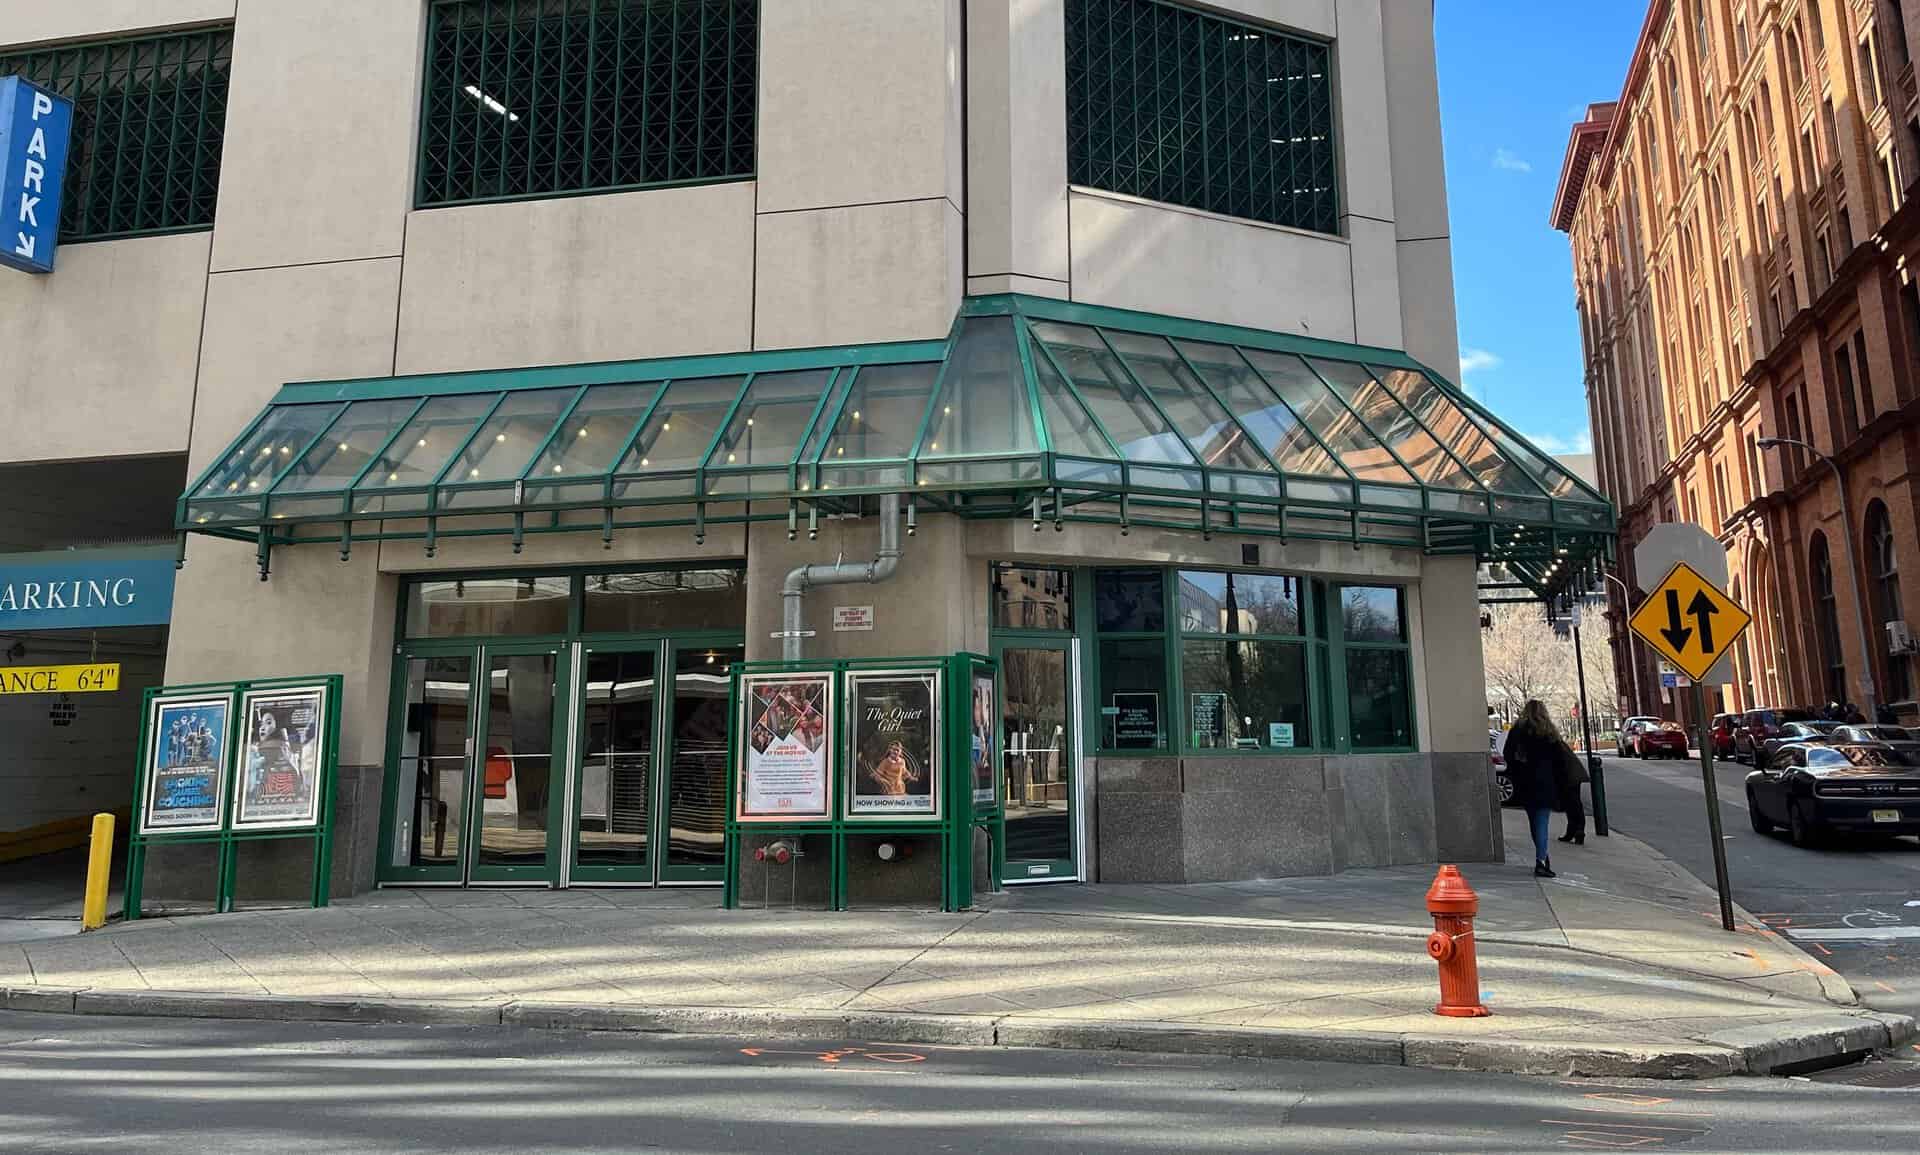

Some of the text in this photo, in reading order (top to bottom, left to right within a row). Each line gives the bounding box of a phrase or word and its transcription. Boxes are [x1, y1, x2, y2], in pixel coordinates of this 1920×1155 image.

[19, 91, 53, 228] PARK
[0, 577, 136, 610] ARKING
[78, 669, 114, 690] 6'4"
[866, 706, 923, 724] The Quiet
[878, 718, 904, 732] Girl
[856, 799, 873, 807] NOW
[874, 799, 906, 807] SHOWING
